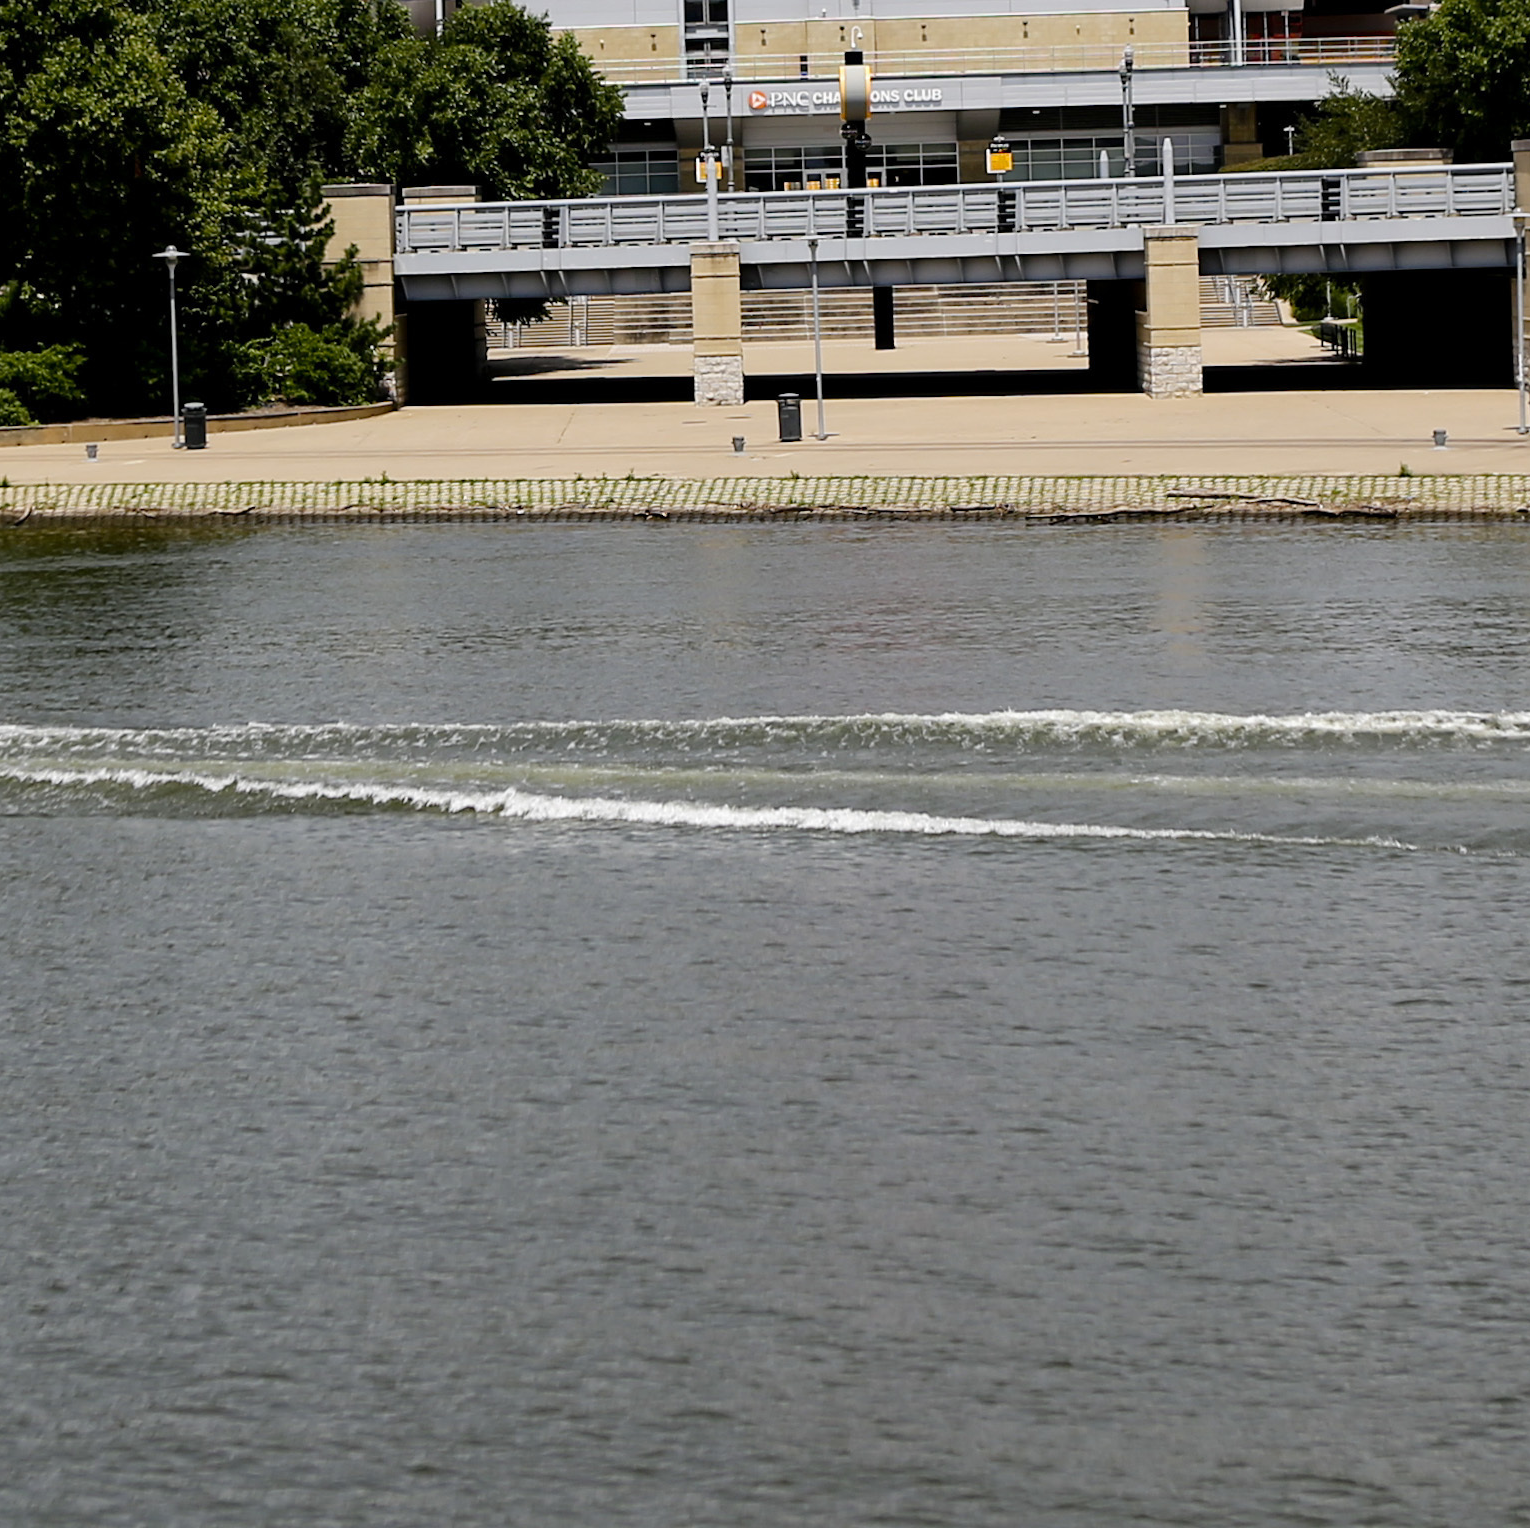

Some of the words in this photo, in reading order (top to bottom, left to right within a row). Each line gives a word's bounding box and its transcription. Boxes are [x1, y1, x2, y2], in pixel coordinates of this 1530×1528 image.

[771, 91, 809, 107] PNC
[812, 90, 900, 106] CHAONS
[903, 88, 942, 102] CLUB
